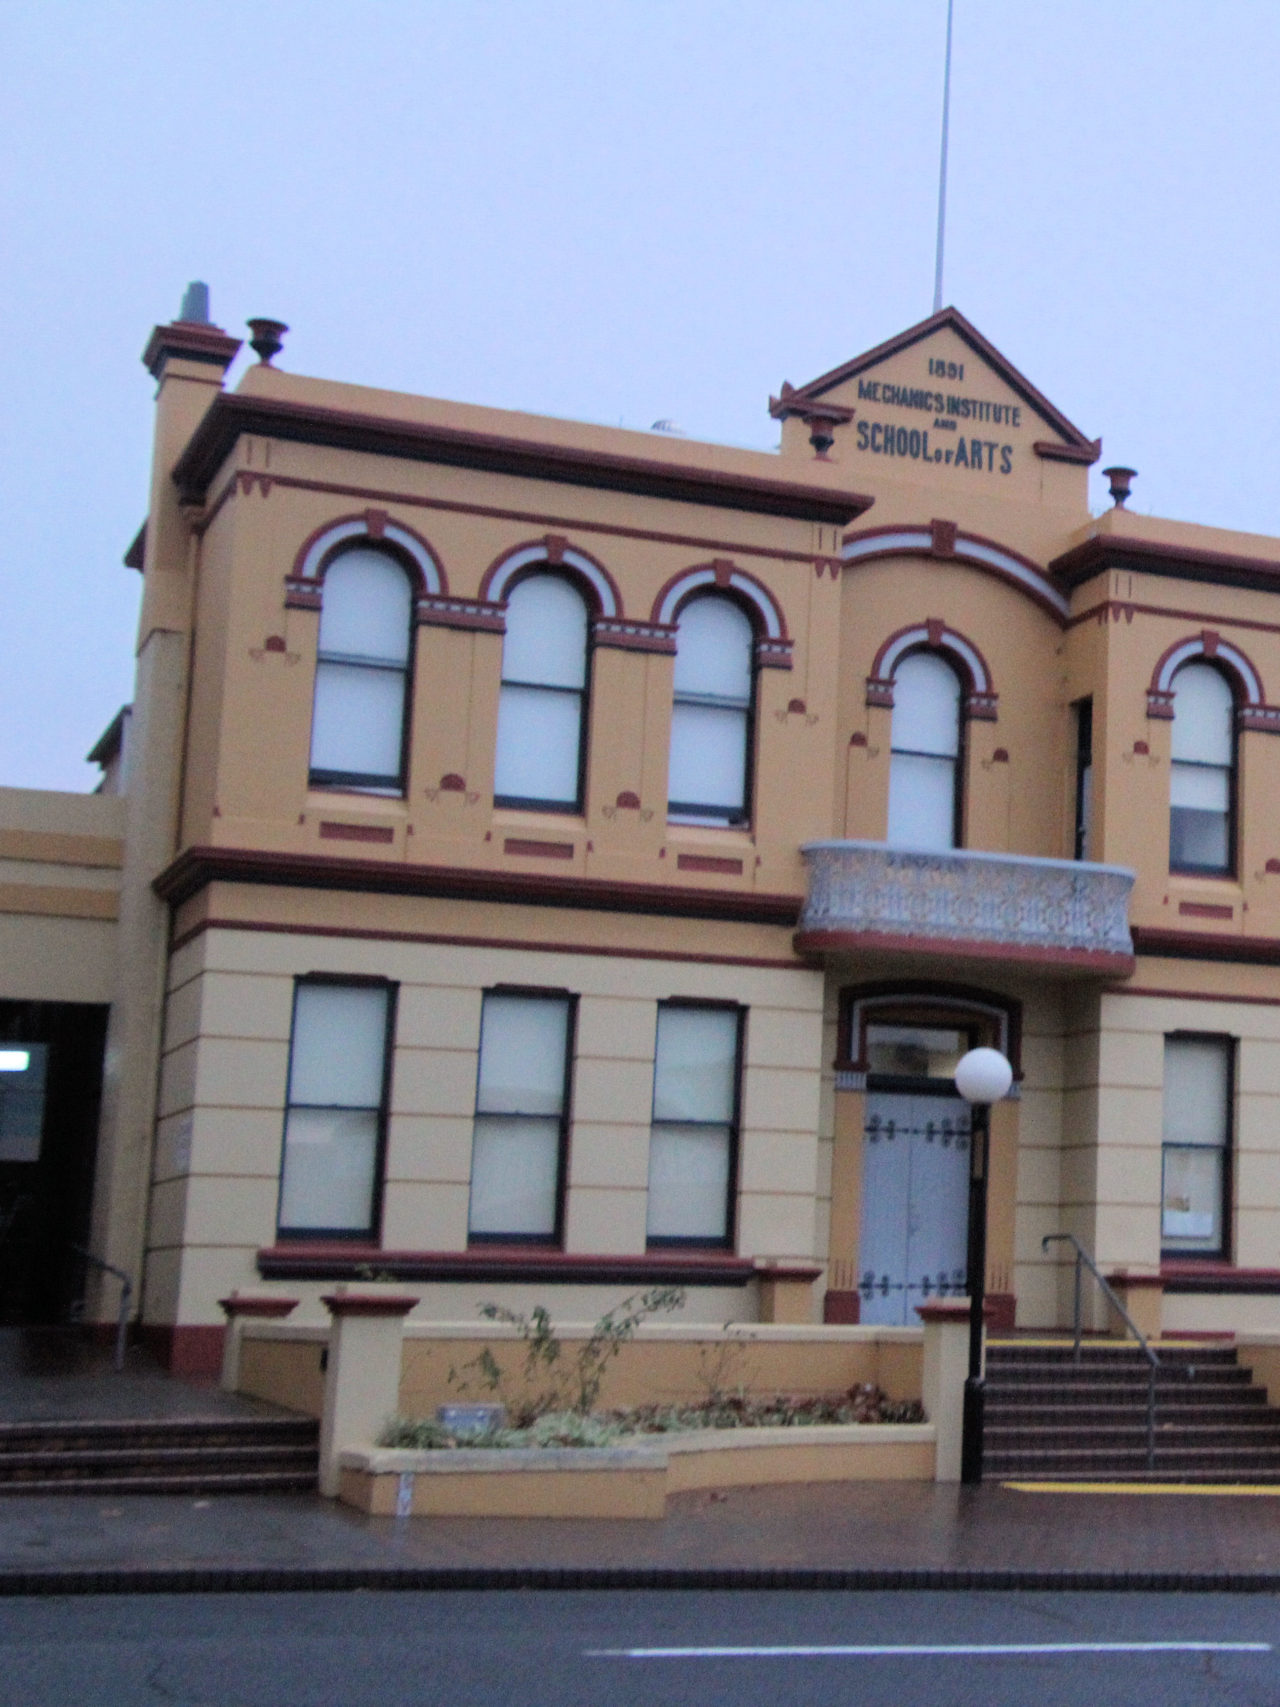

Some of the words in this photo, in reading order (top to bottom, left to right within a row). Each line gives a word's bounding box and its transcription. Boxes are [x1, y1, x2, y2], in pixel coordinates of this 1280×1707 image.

[928, 358, 965, 381] 1891
[933, 418, 957, 432] AND
[946, 395, 1021, 428] INSTITUTE
[857, 420, 934, 463] SCHOOL
[934, 448, 954, 465] OF
[954, 437, 1013, 475] ARTS
